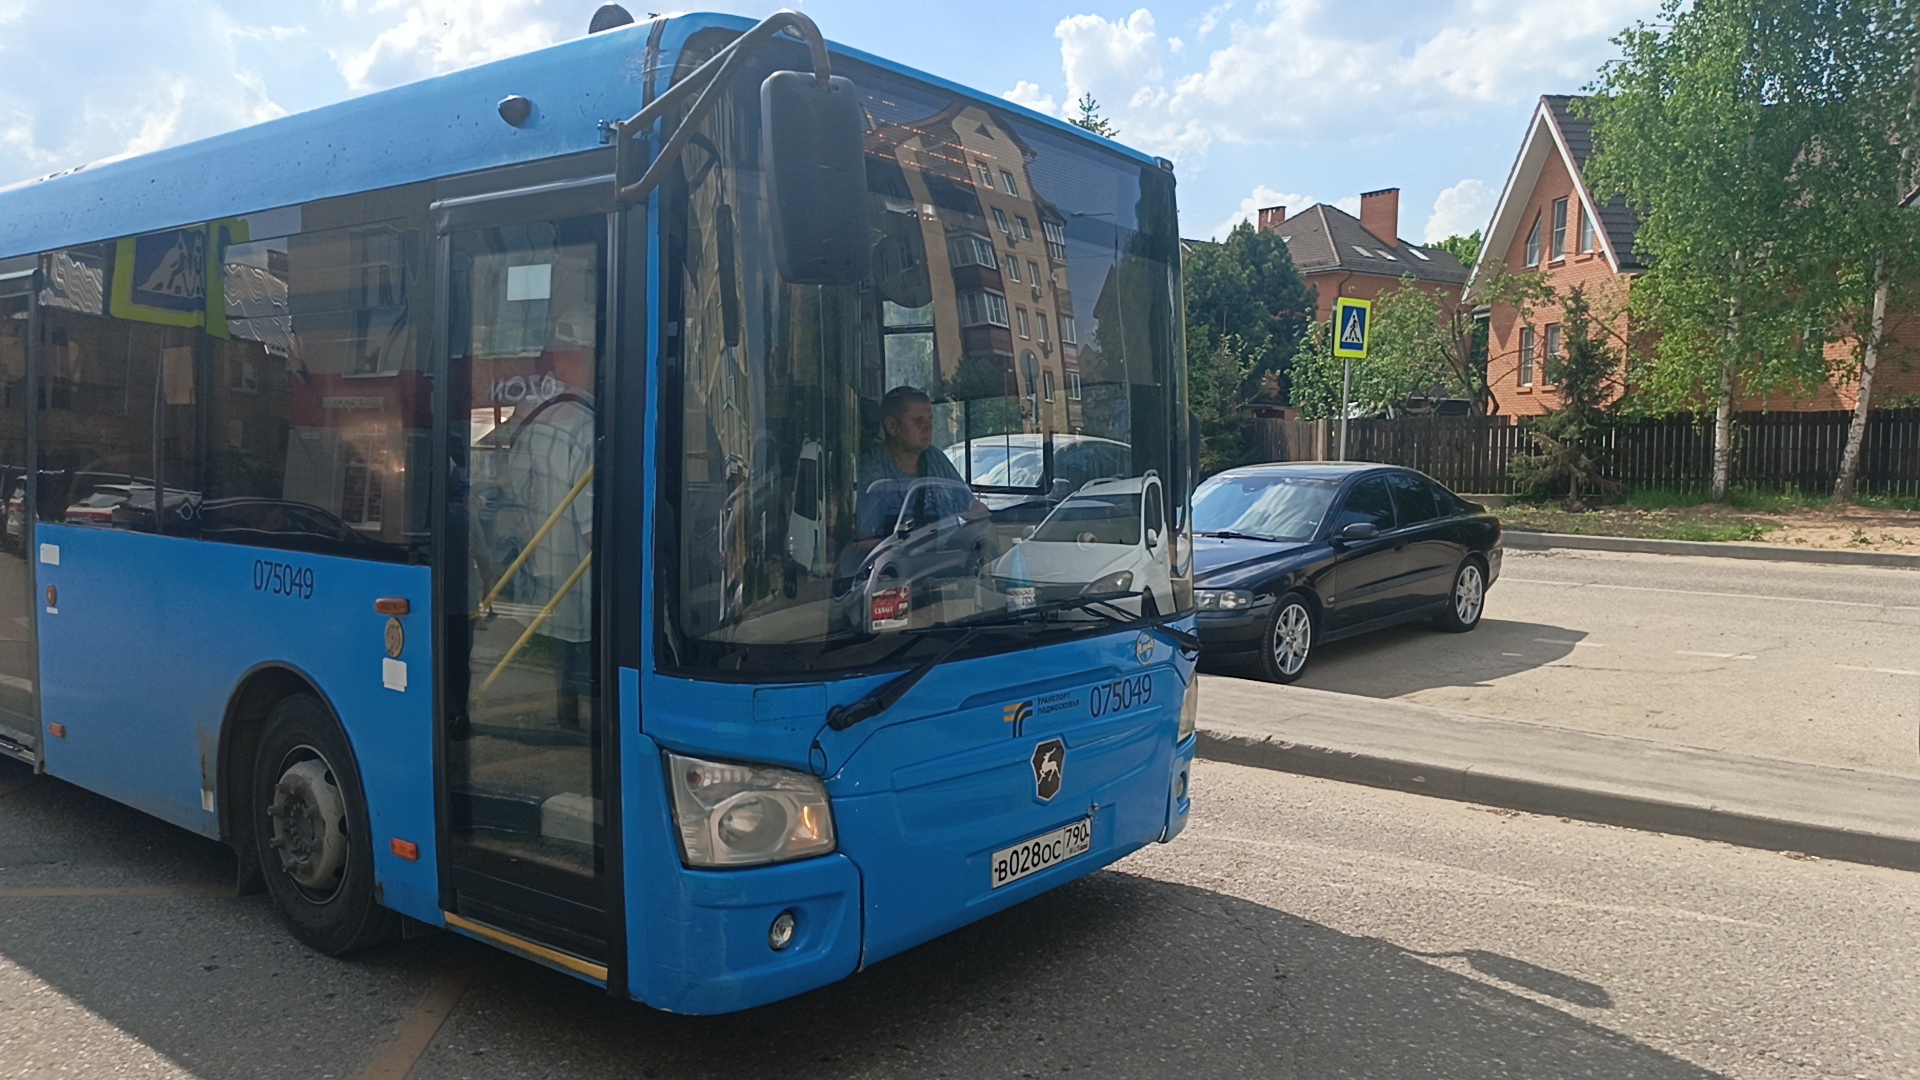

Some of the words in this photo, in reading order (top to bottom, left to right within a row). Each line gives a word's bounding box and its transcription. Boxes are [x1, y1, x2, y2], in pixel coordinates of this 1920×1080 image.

[254, 559, 314, 600] 075049
[1037, 692, 1070, 706] ТРАНСПОРТ
[1037, 699, 1080, 715] ПОДМОСКОВЬЯ
[1090, 673, 1153, 718] 075049
